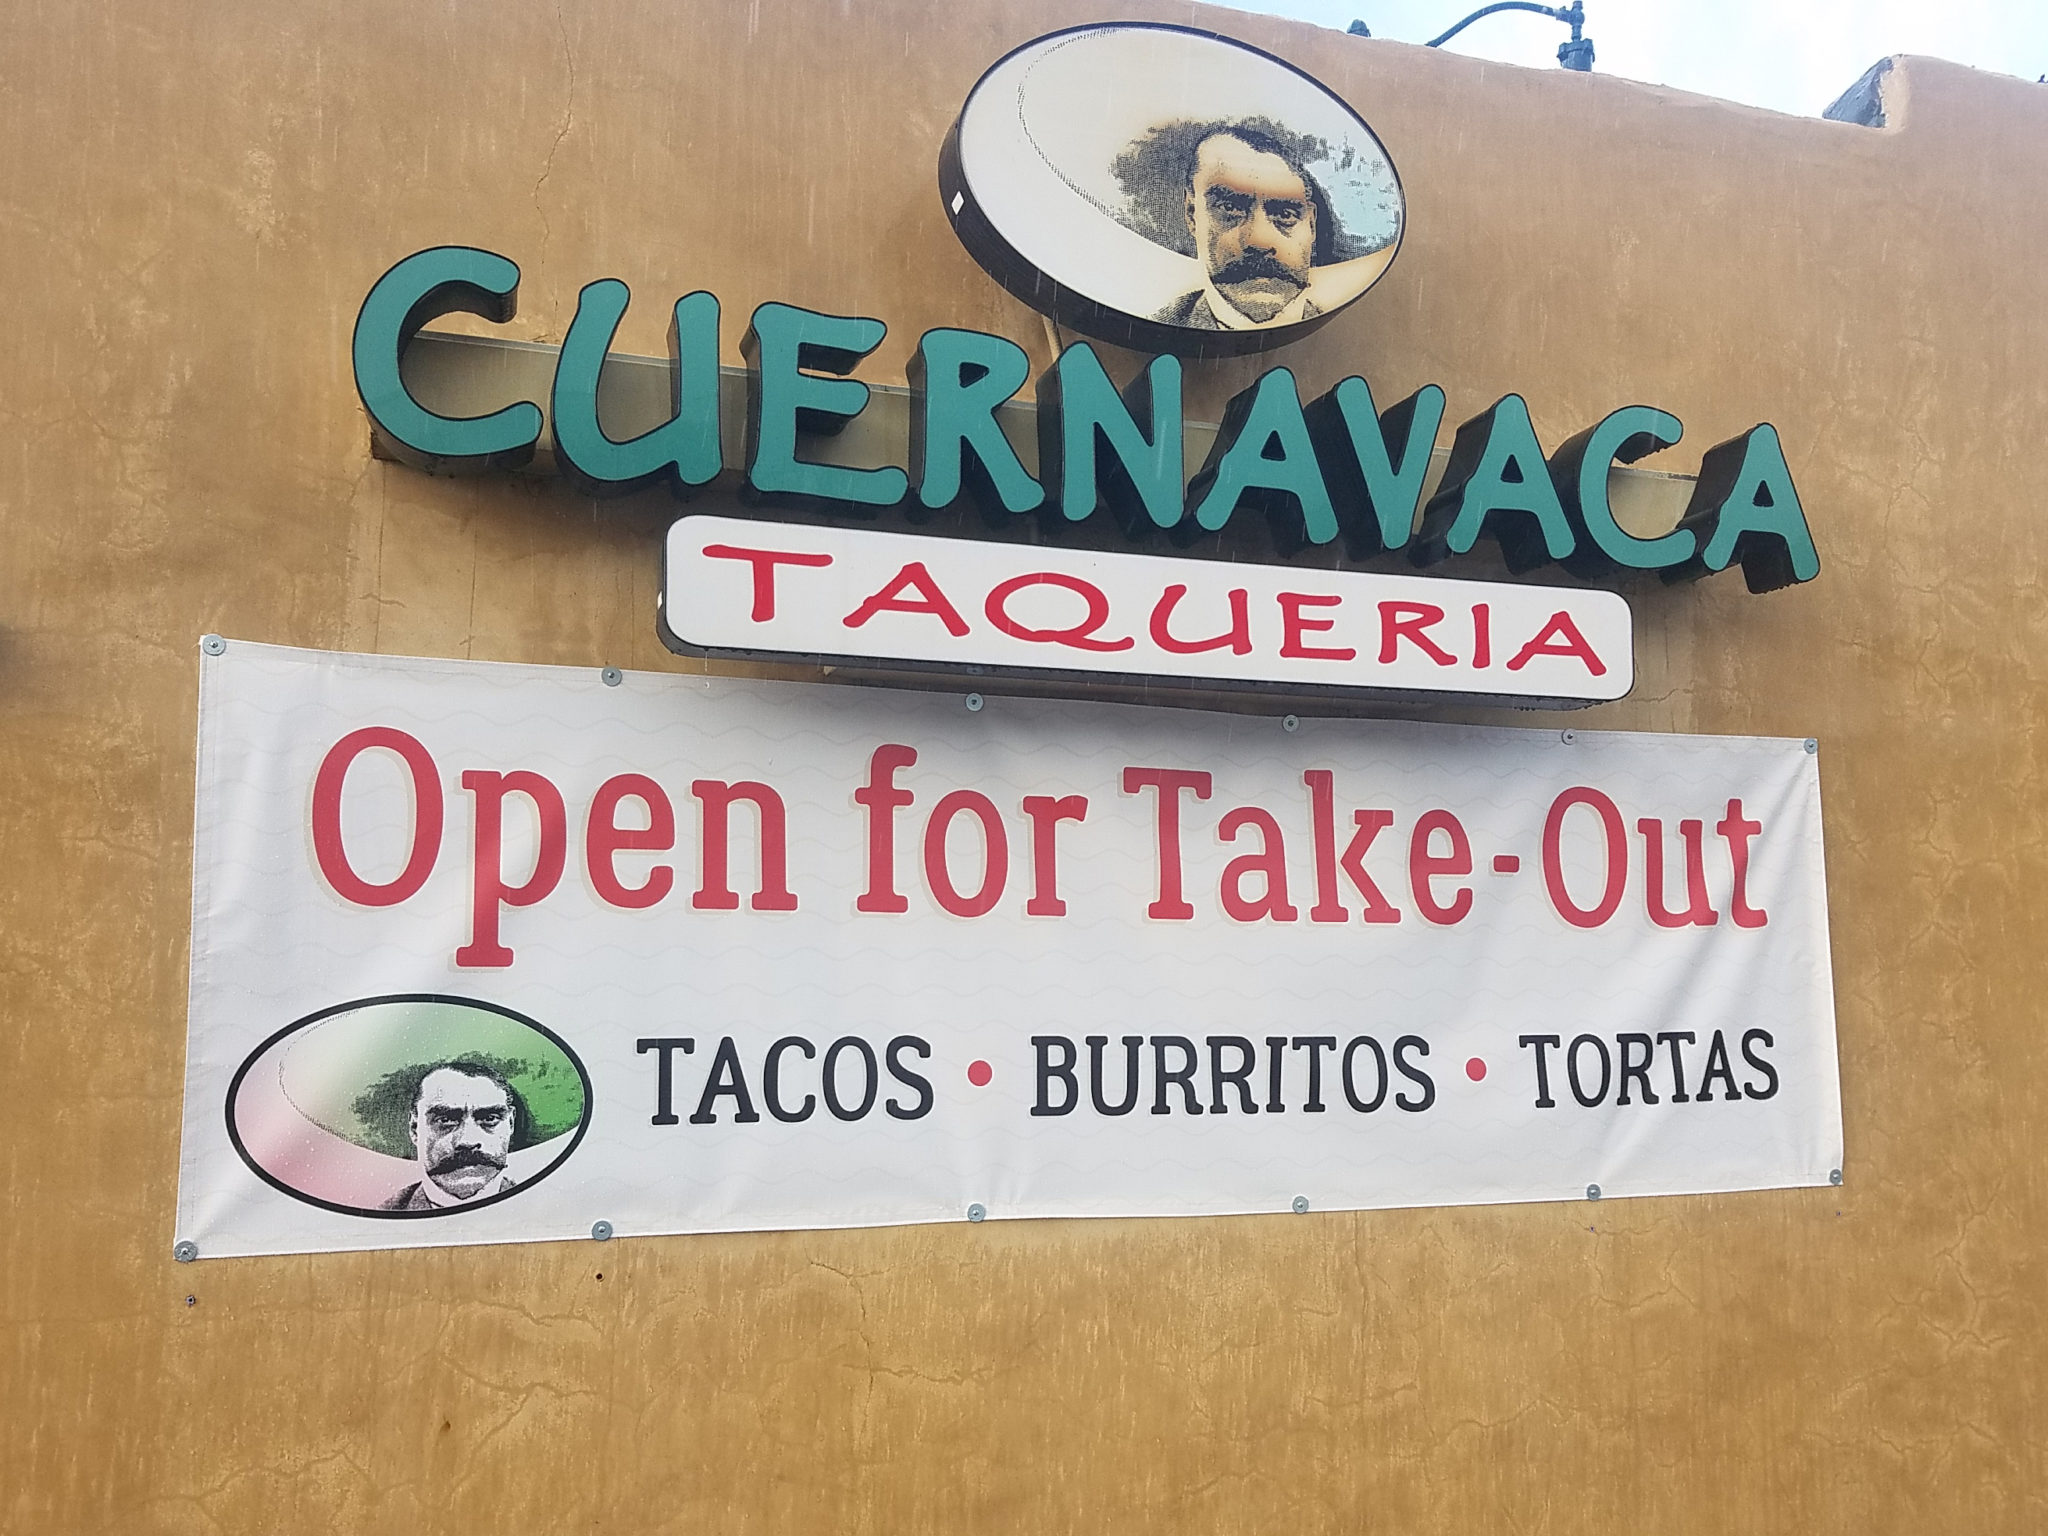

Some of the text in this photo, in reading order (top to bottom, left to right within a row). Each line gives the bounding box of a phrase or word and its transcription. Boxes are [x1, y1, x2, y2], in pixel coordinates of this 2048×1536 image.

[353, 246, 1820, 583] CUERNAVACA
[702, 544, 1607, 677] TAQUERIA
[312, 726, 1768, 968] Open for Take-Out
[636, 1028, 1779, 1126] TACOS BURRITOS TORTAS
